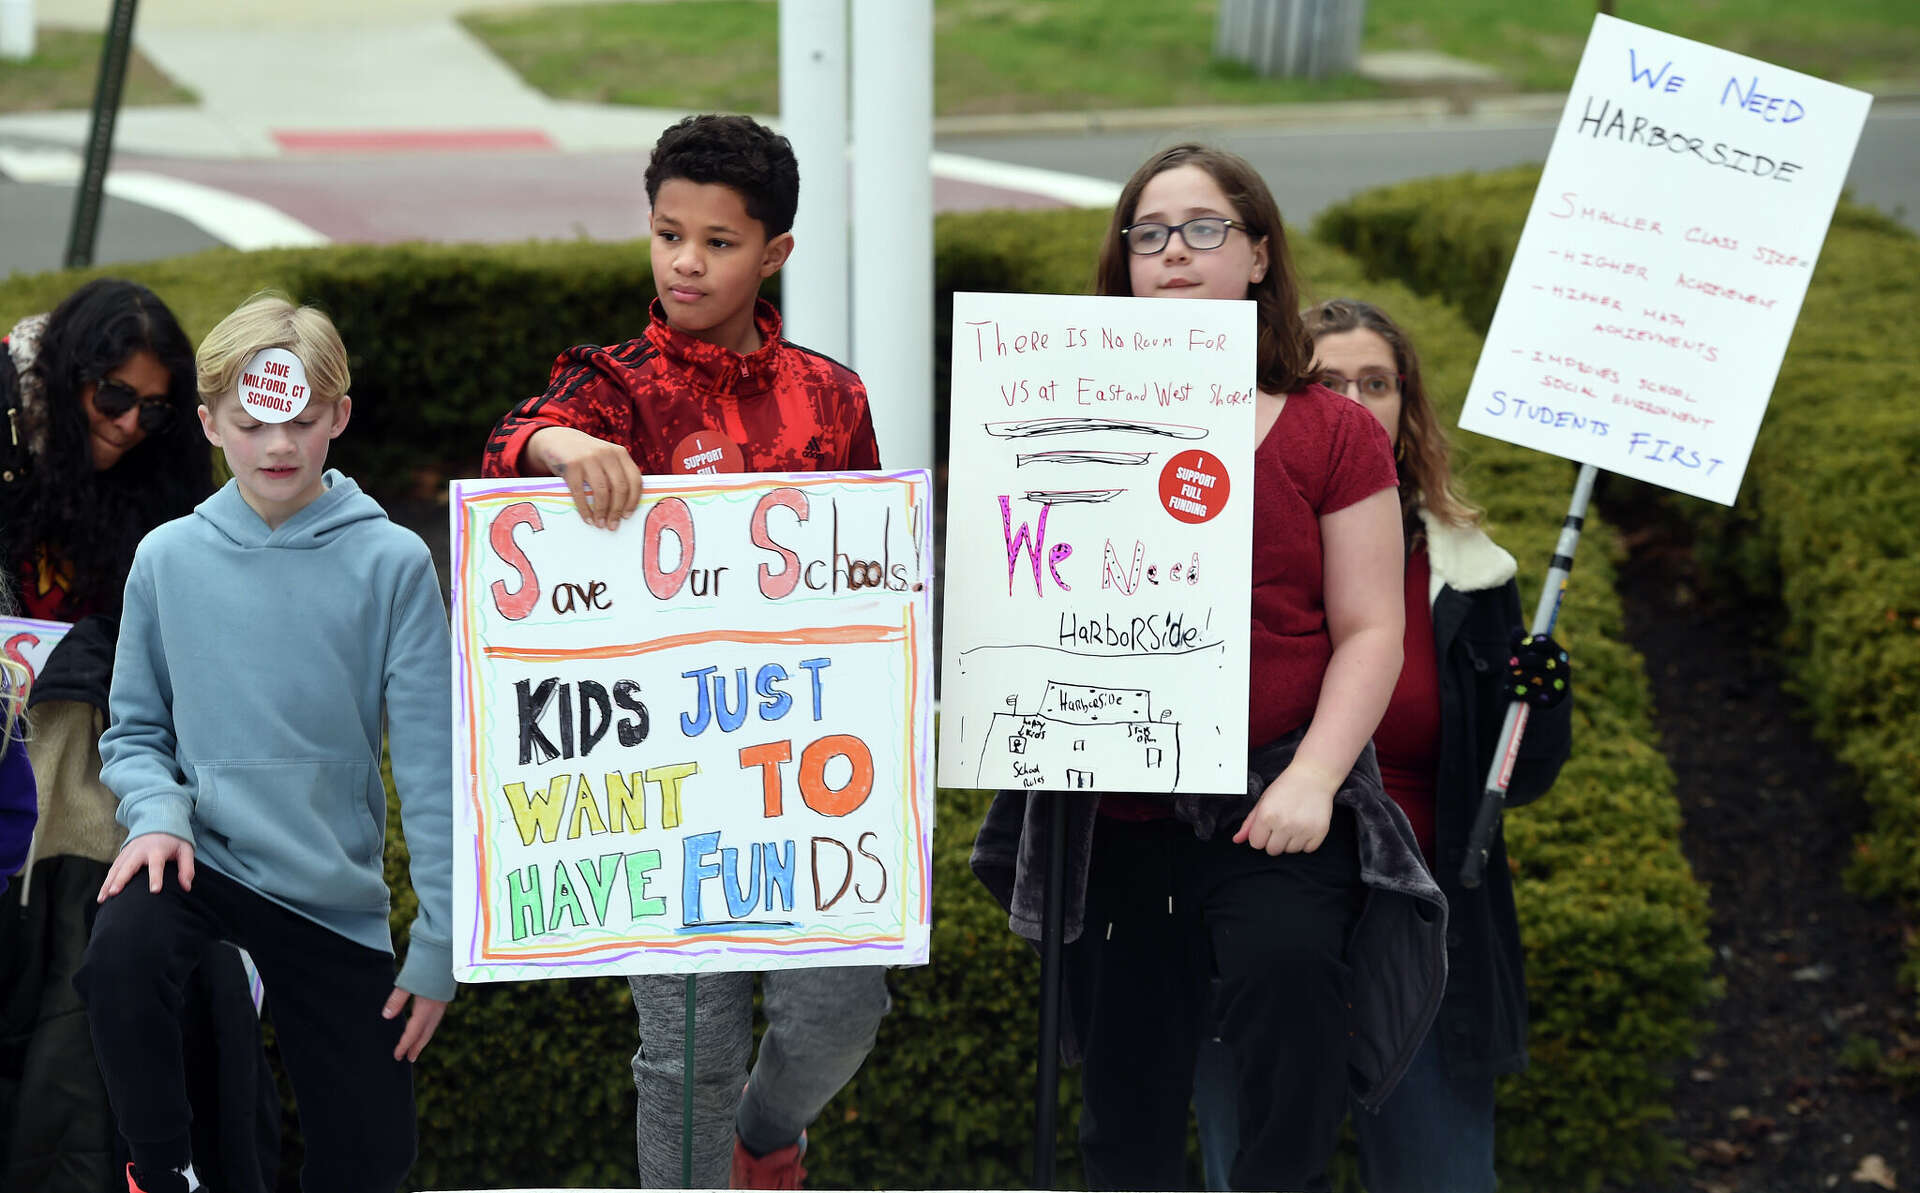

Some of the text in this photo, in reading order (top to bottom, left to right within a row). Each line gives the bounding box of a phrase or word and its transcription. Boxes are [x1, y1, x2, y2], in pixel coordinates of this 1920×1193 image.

[1577, 96, 1804, 183] HARBORSIDE
[1549, 192, 1664, 235] SMALLER
[1064, 327, 1088, 349] IS
[263, 360, 291, 379] SAVE
[242, 372, 306, 400] MILFORD, CT
[1038, 379, 1059, 402] at
[1153, 381, 1193, 407] West
[246, 391, 293, 413] SCHOOLS
[695, 439, 703, 451] I
[1486, 390, 1726, 477] STUDENTS FIRST
[683, 447, 724, 470] SUPPORT
[1197, 456, 1204, 469] I
[1176, 466, 1217, 488] SUPPORT
[1168, 495, 1208, 517] FUNDING
[1181, 483, 1203, 501] FULL
[489, 486, 925, 621] Save Our Schools!
[997, 495, 1201, 597] We Need
[513, 656, 832, 766] KIDS JUST
[502, 733, 875, 847] WANT TO
[506, 848, 667, 941] HAVE
